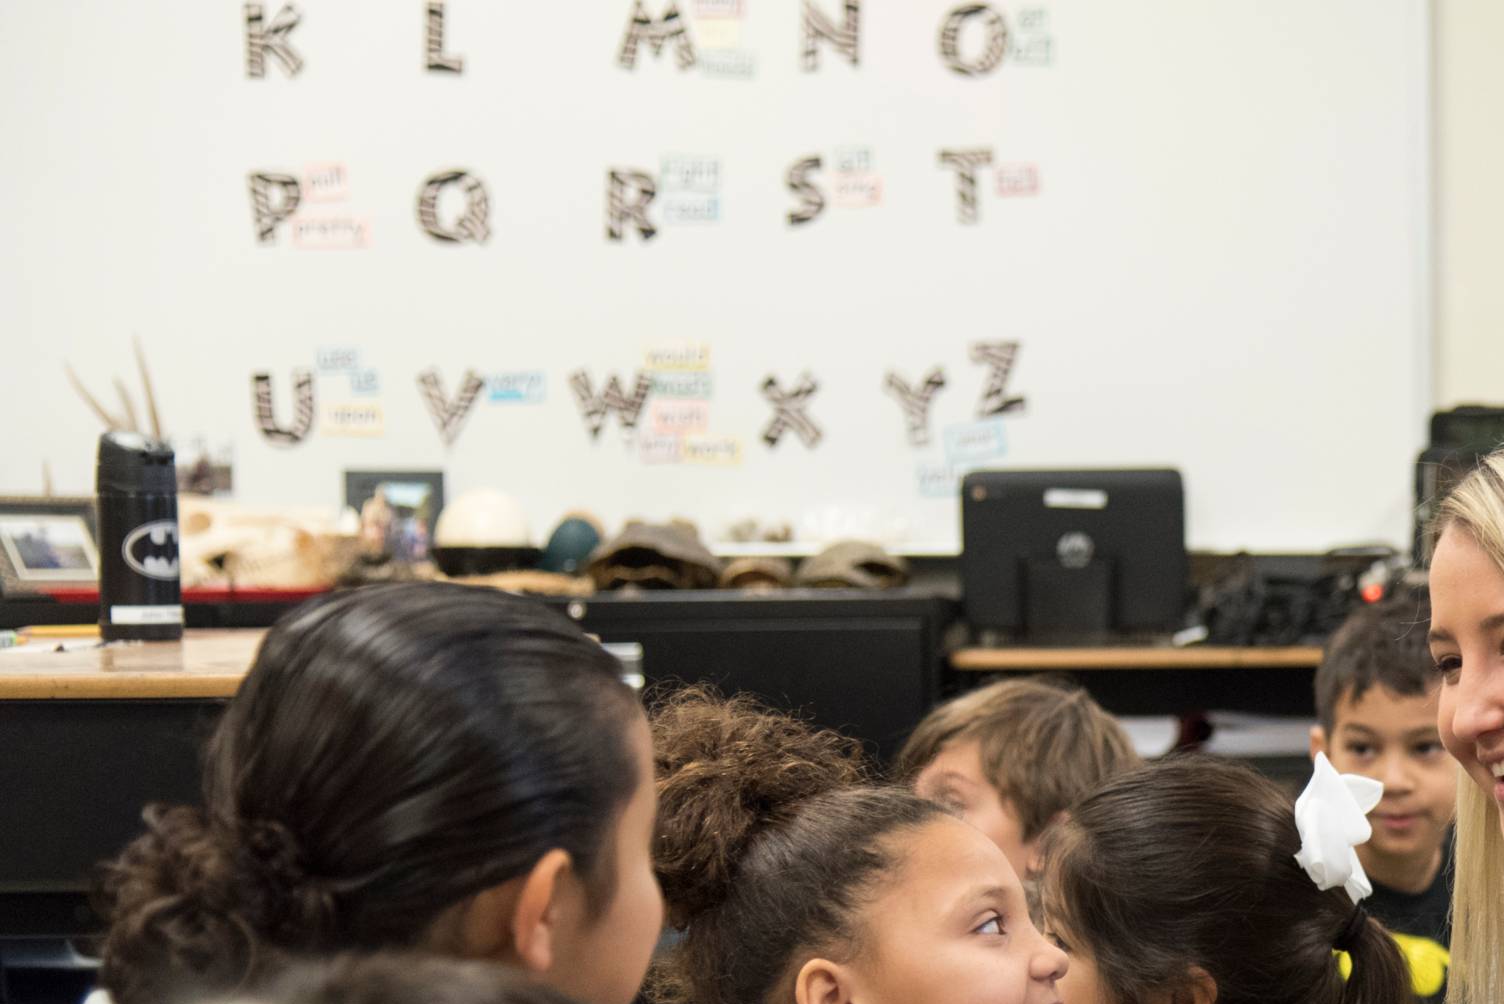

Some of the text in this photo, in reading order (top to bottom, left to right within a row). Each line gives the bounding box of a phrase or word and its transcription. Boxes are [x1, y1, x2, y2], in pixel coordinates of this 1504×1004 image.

[243, 0, 1009, 80] K L M N O
[248, 149, 994, 246] P Q R S T
[250, 340, 1028, 450] U V W X Y Z
